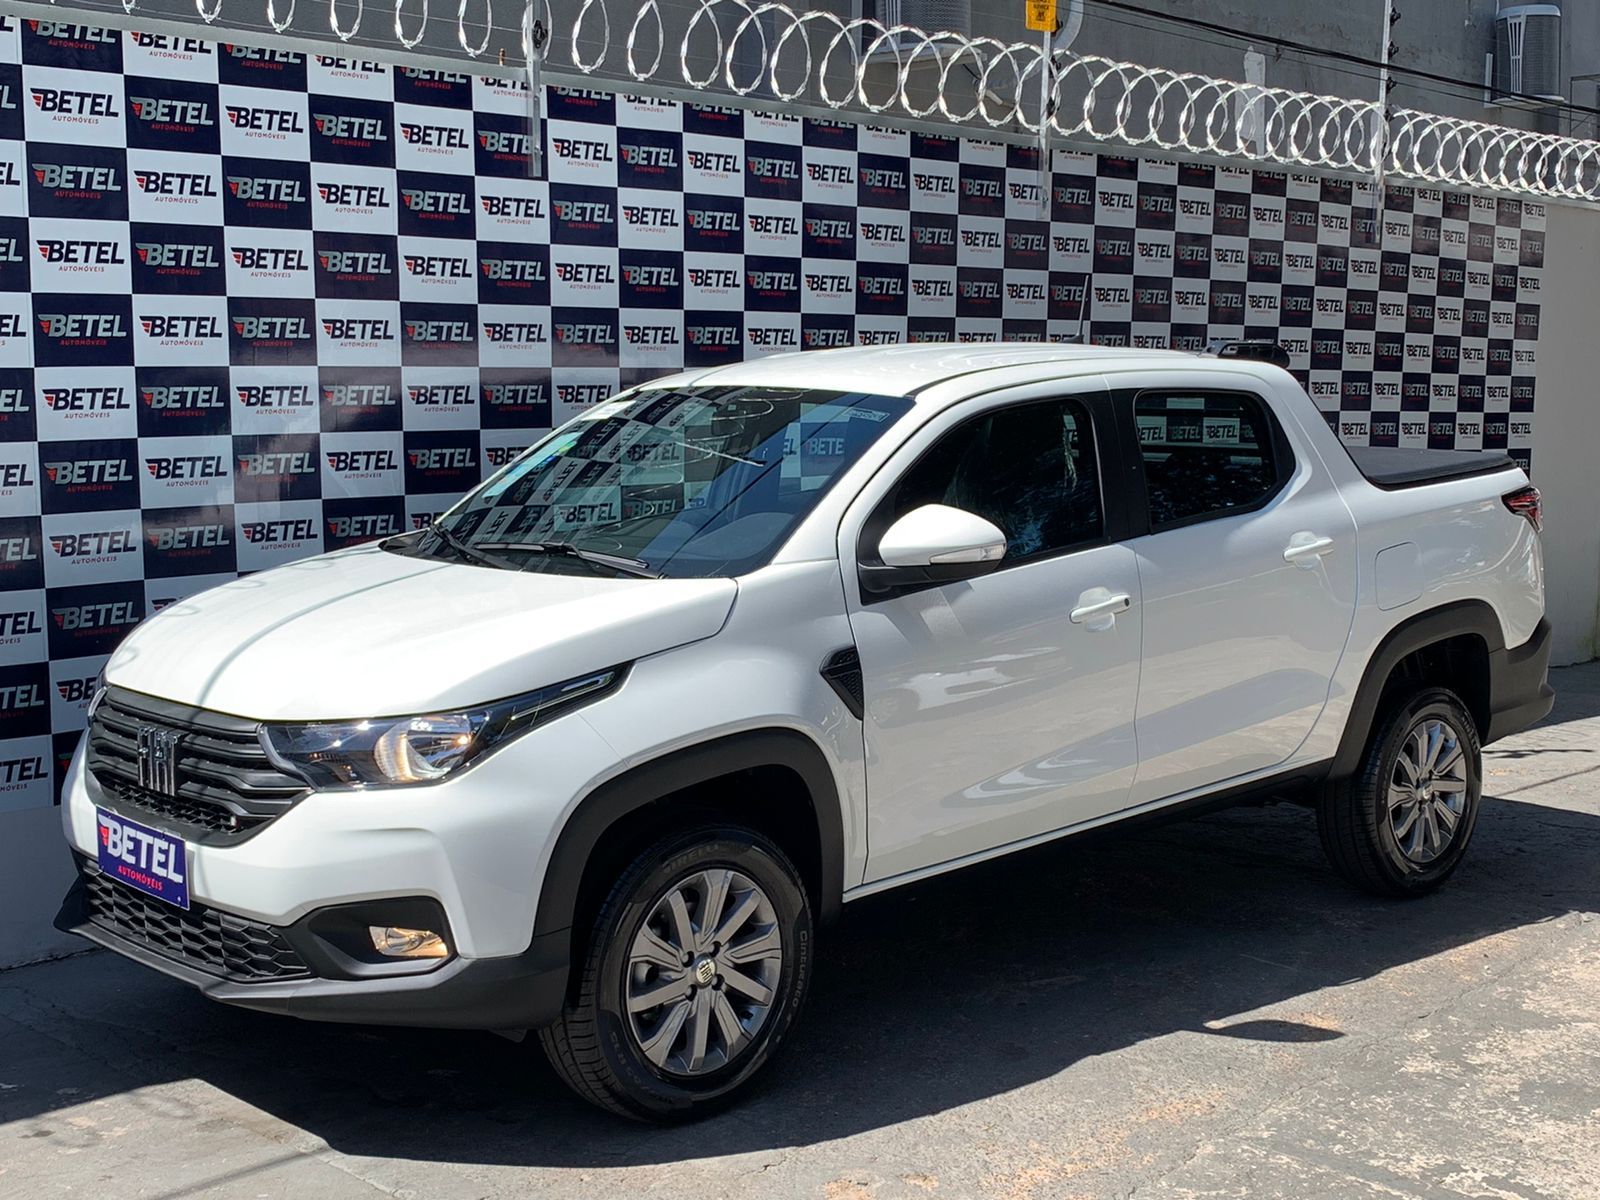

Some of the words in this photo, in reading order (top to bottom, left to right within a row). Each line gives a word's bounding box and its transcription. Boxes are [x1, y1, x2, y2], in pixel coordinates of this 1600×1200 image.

[149, 49, 194, 60] AUTOMÓVEIS
[29, 87, 119, 117] BETEL
[129, 96, 213, 125] BETEL
[52, 115, 100, 124] AUTOMÓVEIS
[225, 105, 304, 133] BETEL
[313, 113, 389, 141] BETEL
[244, 130, 286, 140] AUTOMÓVEIS
[400, 122, 469, 149] BETEL
[477, 130, 535, 153] BETE
[552, 137, 613, 162] BETEL
[620, 144, 678, 167] BETEL
[687, 150, 740, 173] BETEL
[747, 156, 798, 178] BETEL
[32, 163, 121, 191] BETEL
[133, 169, 217, 196] BETEL
[806, 162, 854, 184] BETEL
[860, 167, 906, 188] BETEL
[913, 173, 955, 193] BETEL
[154, 195, 199, 204] AUTOMÓVEIS
[227, 176, 305, 202] BETEL
[316, 182, 392, 208] BETEL
[1098, 191, 1134, 208] BETEL
[401, 188, 470, 213] BETEL
[480, 195, 545, 218] BETEL
[553, 200, 613, 222] BETEL
[1179, 199, 1211, 216] BETEL
[622, 205, 679, 227] BETEL
[686, 209, 740, 230] BETEL
[748, 214, 798, 235] BETEL
[1252, 206, 1282, 223] BETEL
[1320, 214, 1348, 230] BETEL
[805, 218, 852, 238] BETEL
[860, 222, 906, 242] BETEL
[960, 229, 1001, 248] BETEL
[36, 239, 125, 264] BETEL
[135, 242, 219, 267] BETEL
[1052, 236, 1090, 253] BETEL
[1137, 242, 1171, 258] BETEL
[1214, 247, 1245, 263] BETEL
[230, 246, 308, 270] BETEL
[318, 250, 393, 274] BETEL
[403, 255, 472, 277] BETEL
[1285, 253, 1313, 268] BETEL
[1350, 259, 1377, 274] BETEL
[480, 259, 545, 280] BETEL
[554, 262, 614, 283] BETEL
[622, 265, 679, 285] BETEL
[687, 268, 740, 288] BETEL
[747, 271, 797, 290] BETEL
[805, 274, 852, 292] BETEL
[858, 276, 904, 294] BETEL
[911, 279, 953, 296] BETEL
[1006, 283, 1045, 299] BETEL
[1094, 287, 1129, 302] BETEL
[1174, 290, 1206, 305] BETEL
[1248, 294, 1278, 309] BETEL
[1316, 298, 1343, 312] BETEL
[37, 314, 126, 337] BETEL
[139, 315, 222, 337] BETEL
[232, 316, 310, 338] BETEL
[321, 318, 395, 340] BETEL
[404, 320, 473, 341] BETEL
[483, 322, 547, 342] BETEL
[555, 324, 614, 343] BETEL
[623, 325, 679, 344] BETEL
[687, 326, 739, 344] BETEL
[747, 327, 797, 345] BETEL
[804, 328, 851, 346] BETEL
[858, 330, 903, 344] BETEL
[1345, 341, 1372, 354] BETEL
[140, 386, 224, 408] BETEL
[235, 385, 313, 406] BETEL
[323, 385, 396, 405] BETEL
[407, 385, 475, 404] BETEL
[483, 385, 546, 403] BETEL
[1311, 382, 1339, 394] BETEL
[41, 387, 130, 411] BETEL
[1205, 424, 1238, 439] BETEL
[1341, 423, 1367, 435] BETEL
[806, 437, 845, 455] BETE
[144, 455, 227, 479] BETEL
[237, 452, 315, 475] BETEL
[326, 450, 399, 471] BETEL
[407, 448, 475, 468] BETEL
[44, 459, 132, 484] BETEL
[165, 479, 209, 487] AUTOMÓVEIS
[240, 519, 318, 543] BETEL
[327, 514, 399, 537] BETEL
[49, 530, 137, 557] BETEL
[147, 524, 229, 549] BETEL
[260, 542, 301, 550] AUTOMÓVEIS
[71, 555, 118, 565] AUTOMÓVEIS
[0, 610, 41, 639] TEL
[51, 601, 139, 629] BETEL
[0, 683, 43, 713] TEL
[0, 756, 48, 787] TEL
[98, 814, 183, 883] BETEL
[118, 865, 163, 890] AUTOMÓVEIS
